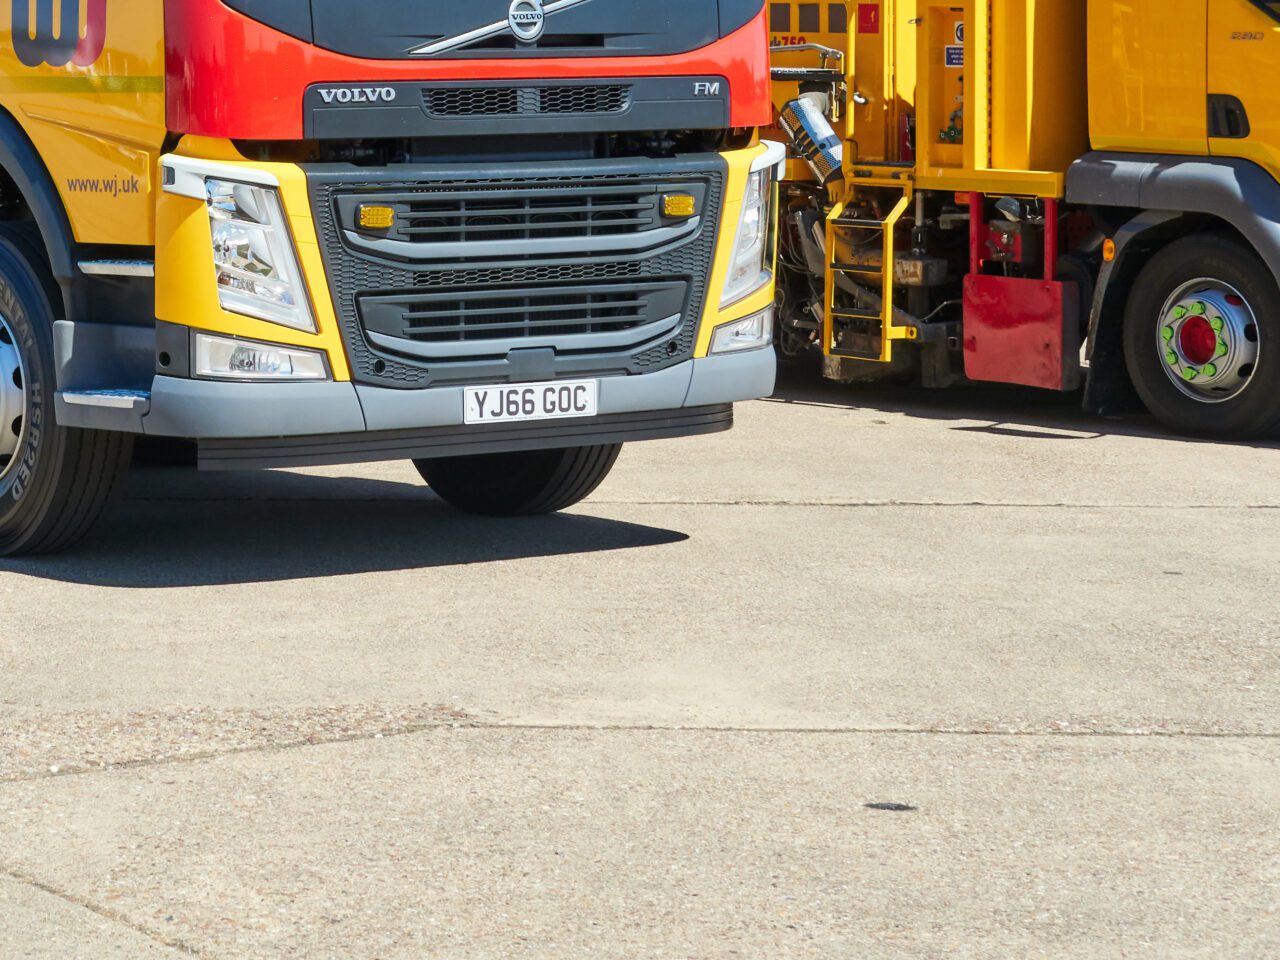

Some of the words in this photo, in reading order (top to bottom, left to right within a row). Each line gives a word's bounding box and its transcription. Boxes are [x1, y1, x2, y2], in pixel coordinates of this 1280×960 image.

[317, 87, 396, 103] VOLVO
[693, 82, 719, 95] FM
[67, 174, 139, 197] www.wj.uk
[474, 389, 535, 418] YJ66
[543, 385, 586, 413] GOC
[12, 382, 41, 501] HSR2ED
